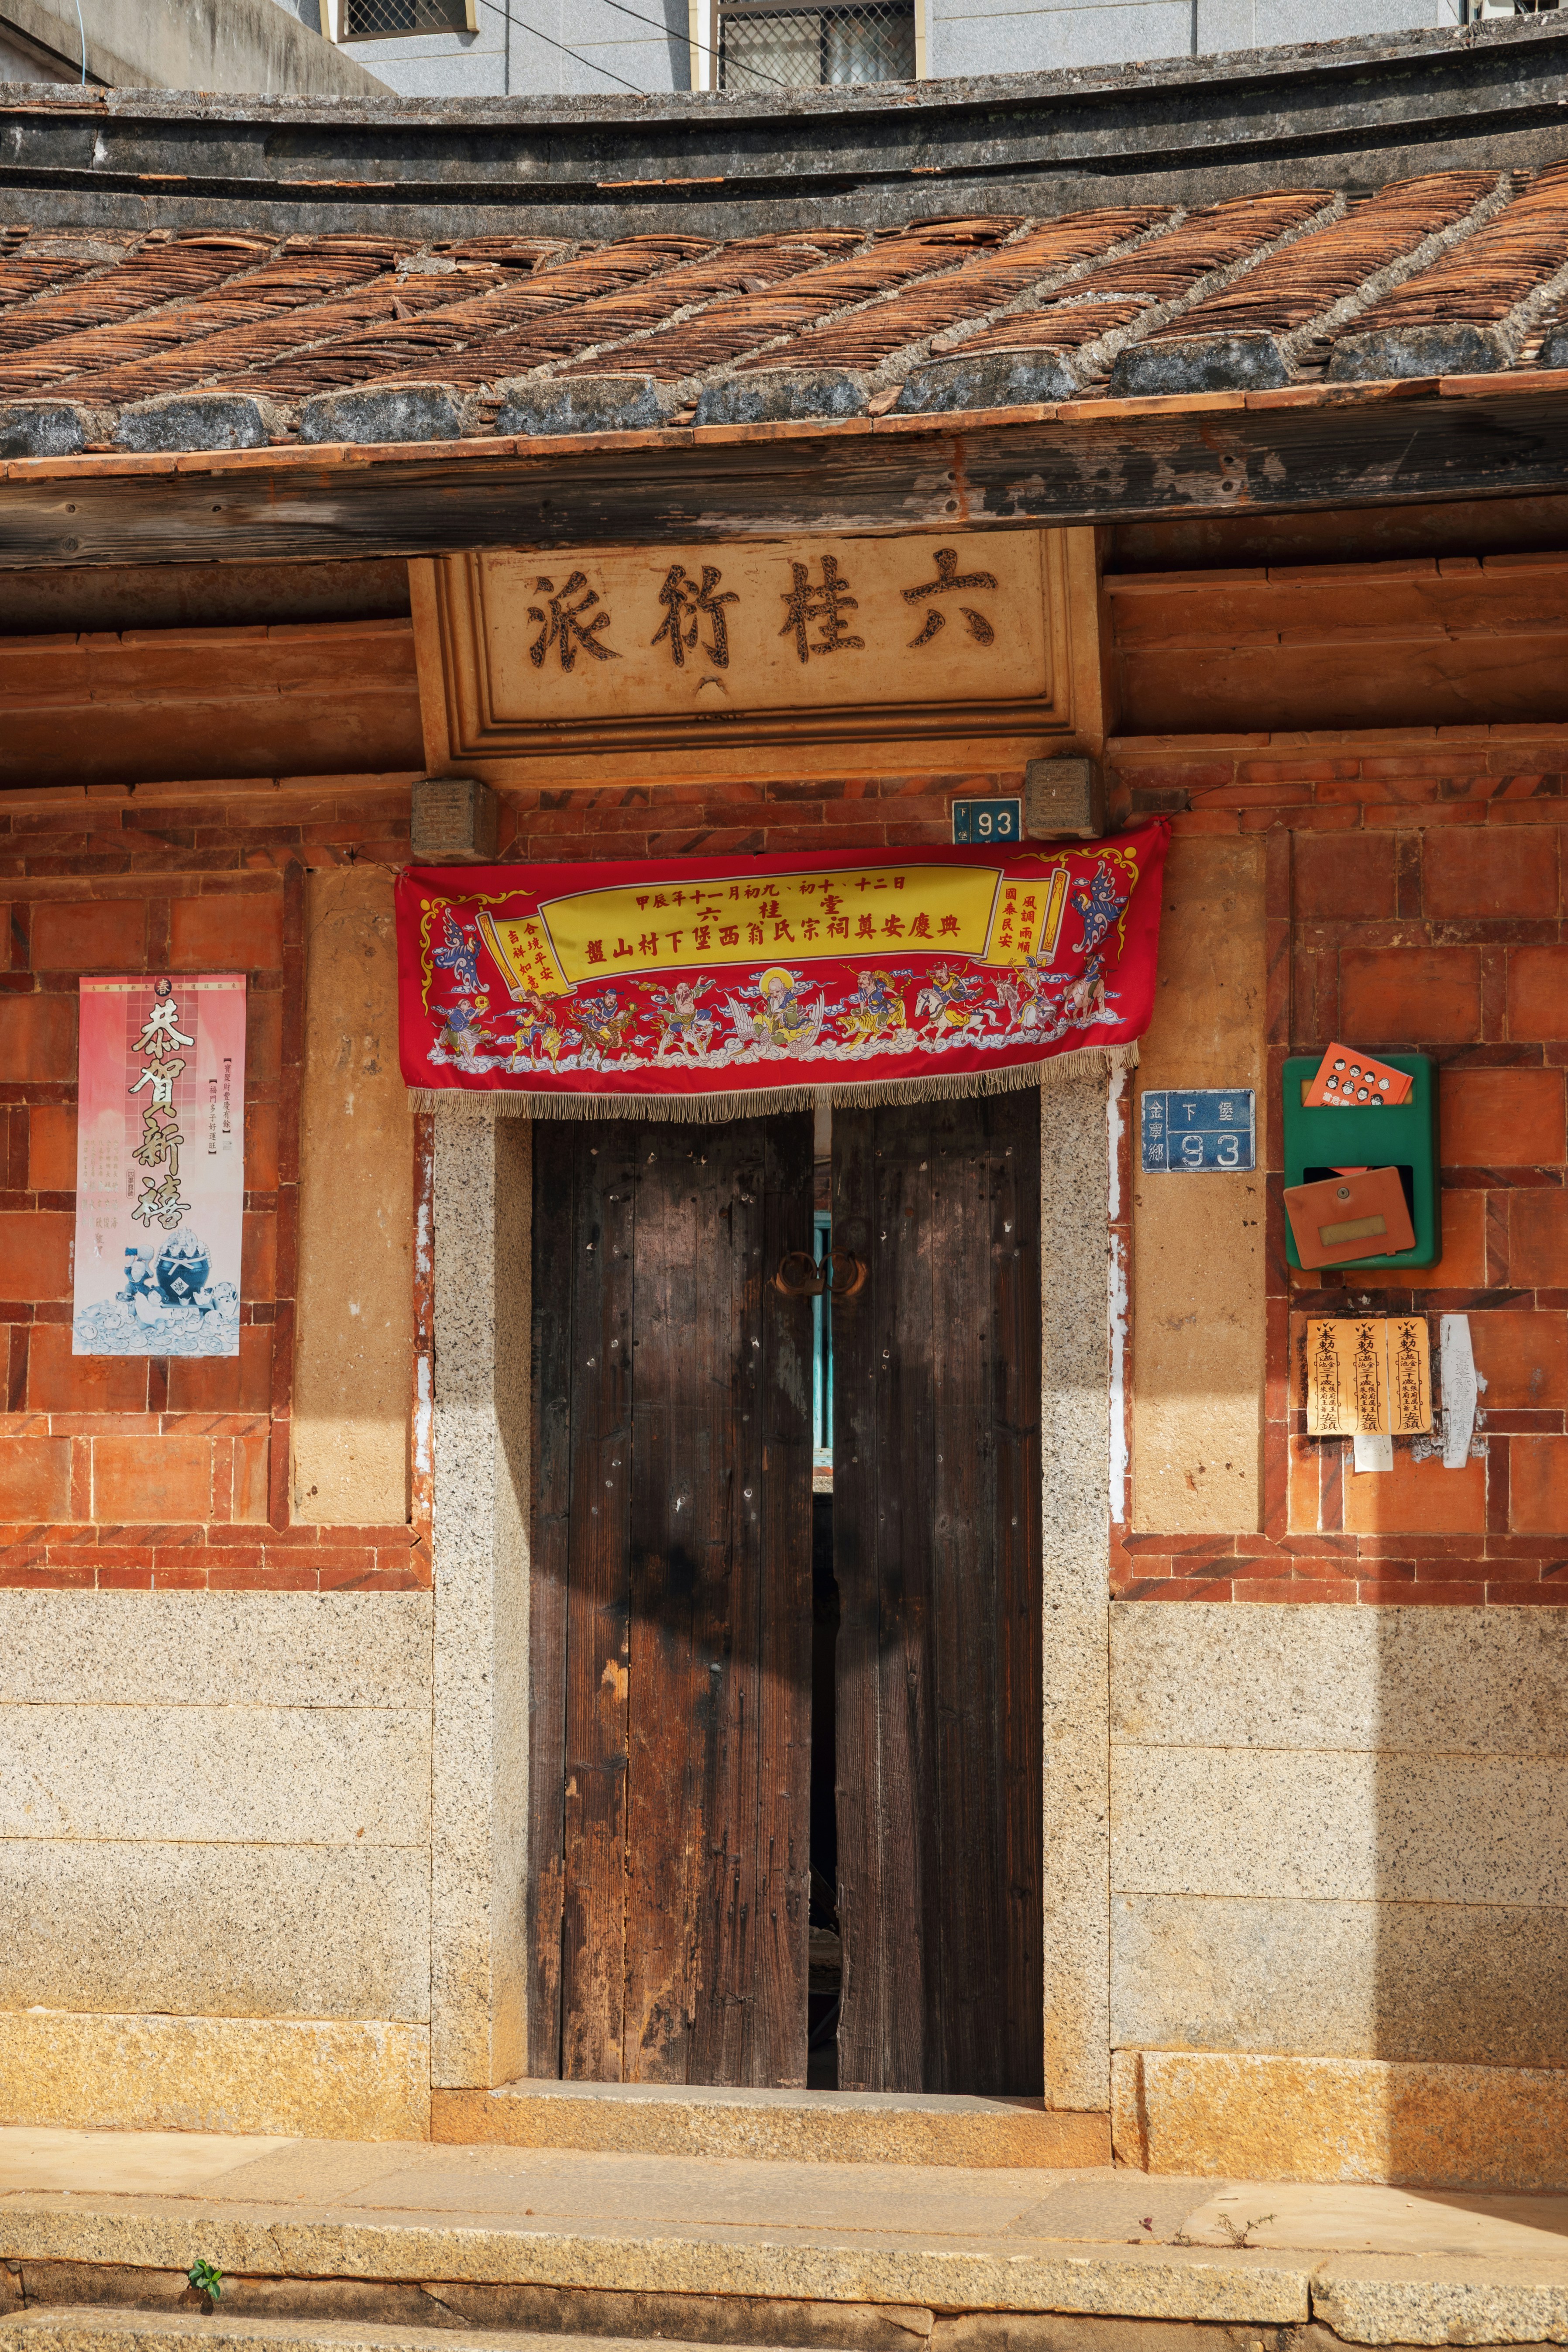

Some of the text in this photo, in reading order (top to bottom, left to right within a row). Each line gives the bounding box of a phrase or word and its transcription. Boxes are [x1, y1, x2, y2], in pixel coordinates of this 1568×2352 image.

[527, 548, 999, 673] 六桂衍派
[958, 808, 967, 840] 下堡
[978, 812, 1011, 836] 93
[697, 894, 844, 922] 六桂堂
[998, 887, 1018, 948] 國泰民安
[1017, 896, 1037, 954] 風調雨順
[508, 930, 539, 990] 吉祥如意
[524, 923, 554, 981] 合境平安
[585, 912, 961, 965] 盤山村下堡西翁氏宗祠奠安慶典
[156, 979, 171, 995] 春
[128, 998, 195, 1230] 恭賀新禧
[1182, 1101, 1234, 1121] 下堡
[1322, 1092, 1355, 1106] 當危機
[1148, 1100, 1164, 1162] 金寧鄉
[1182, 1135, 1239, 1166] 93
